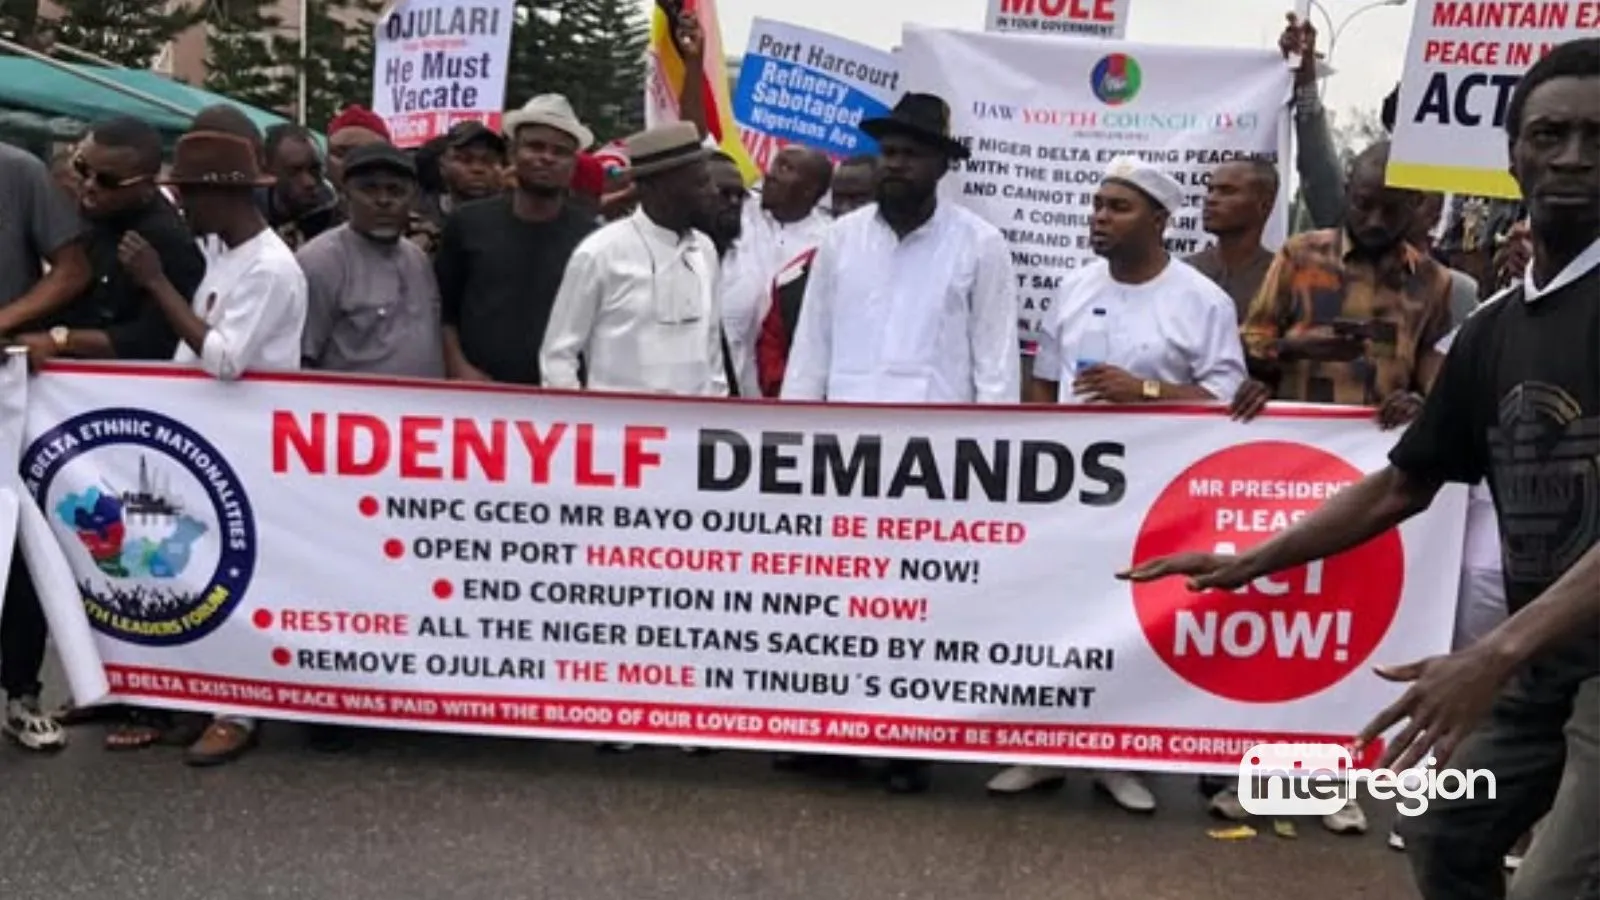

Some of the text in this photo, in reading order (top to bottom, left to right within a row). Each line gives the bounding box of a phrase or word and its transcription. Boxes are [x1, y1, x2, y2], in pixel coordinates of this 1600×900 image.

[387, 6, 499, 41] OJULARI
[1432, 2, 1568, 29] MAINTAIN
[386, 51, 490, 85] He Must
[759, 34, 899, 91] Port Harcourt
[1424, 40, 1500, 65] PEACE
[1506, 42, 1532, 65] IN
[391, 82, 478, 113] Vacate
[762, 60, 849, 101] Refinery
[1414, 72, 1524, 127] ACT
[752, 81, 863, 127] Sabotaged
[1023, 109, 1097, 126] YOUTH
[979, 138, 1032, 157] NIGER
[1037, 147, 1091, 162] DELTA
[963, 181, 997, 197] AND
[1002, 185, 1076, 205] CANNOT
[966, 160, 1009, 175] WITH
[1015, 165, 1047, 181] THE
[1052, 169, 1105, 184] BLOO
[272, 411, 1127, 507] NDENYLF DEMANDS
[31, 418, 247, 550] DELTA ETHNIC NATIONALITIES
[1189, 480, 1352, 499] MR PRESIDEN
[386, 497, 1026, 544] NNPC GCEO MR BAYO OJULARI BE REPLACED
[1215, 509, 1306, 532] PLEAS
[413, 537, 980, 584] OPEN PORT HARCOURT REFINERY NOW!
[182, 584, 230, 630] FORUM
[463, 579, 928, 621] END CORRUPTION IN NNPC NOW!
[280, 609, 1115, 671] RESTORE ALL THE NIGER DELTANS SACKED BY MR OJULARI
[1172, 609, 1353, 661] NOW!
[298, 649, 417, 675] REMOVE
[426, 653, 546, 680] OJULARI
[555, 659, 608, 682] THE
[617, 661, 696, 688] MOLE
[705, 667, 733, 689] IN
[890, 677, 1096, 708] GOVERNMENT
[129, 672, 185, 693] DELTA
[189, 679, 273, 702] EXISTING
[279, 688, 341, 708] PEACE
[343, 692, 386, 711] WAS
[392, 696, 437, 715] PAID
[441, 699, 495, 718] WITH
[499, 702, 539, 721] THE
[545, 703, 611, 724] BLOOD
[617, 708, 645, 726] OF
[648, 710, 691, 729] OUR
[697, 712, 761, 733] LOVED
[768, 717, 821, 736] ONES
[826, 720, 869, 739] AND
[874, 722, 958, 743] CANNOT
[966, 728, 991, 745] BE
[997, 729, 1115, 750] SACRIFICED
[1121, 733, 1163, 752] FOR
